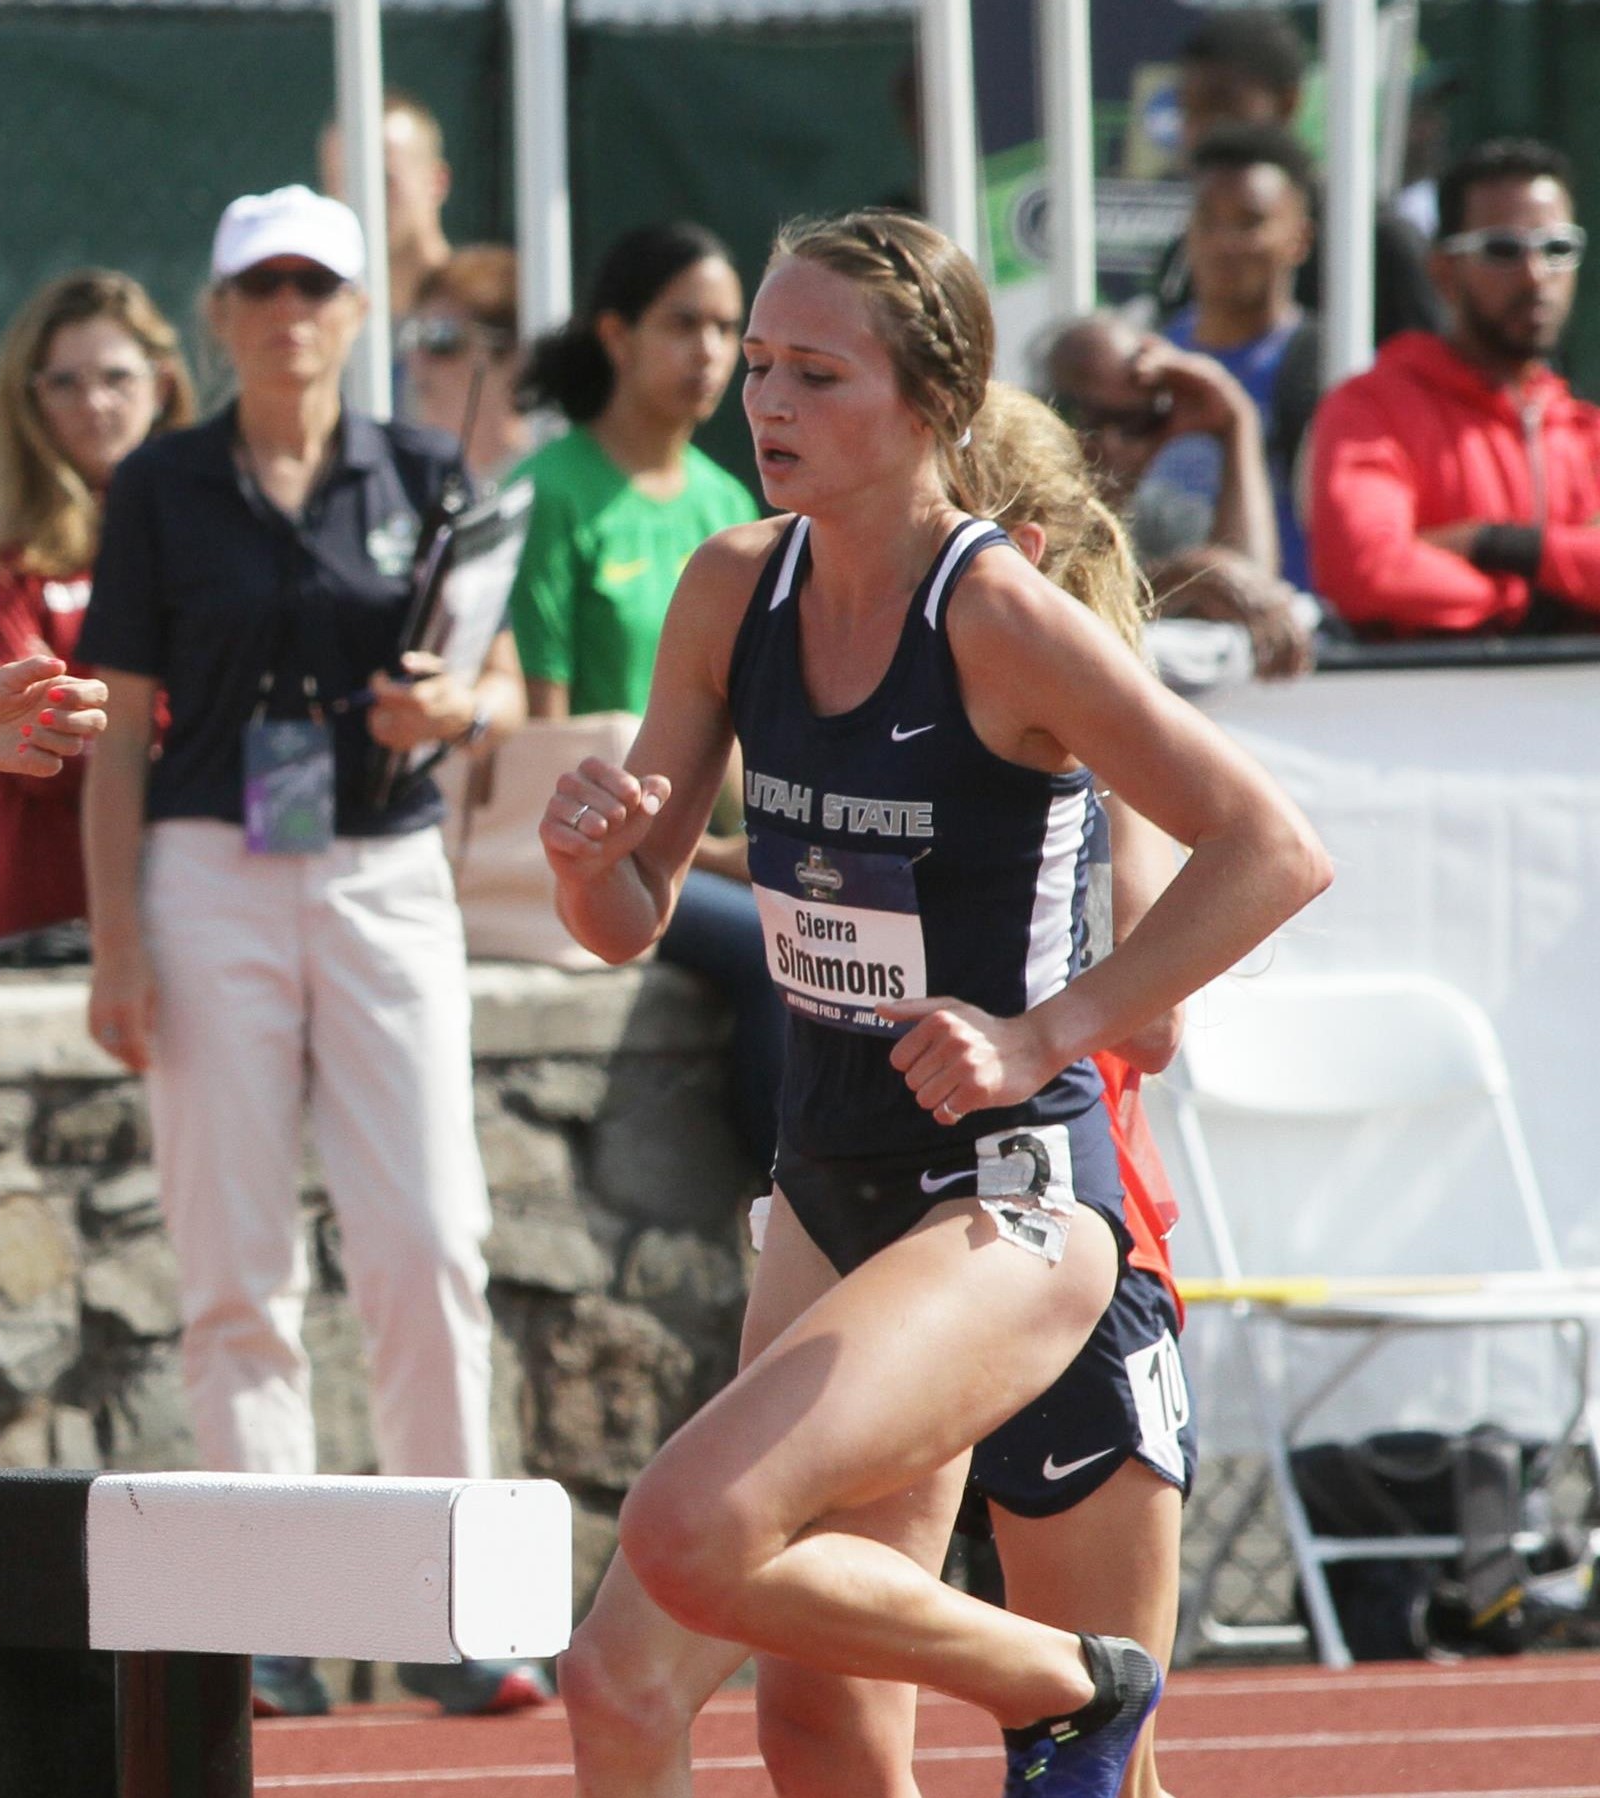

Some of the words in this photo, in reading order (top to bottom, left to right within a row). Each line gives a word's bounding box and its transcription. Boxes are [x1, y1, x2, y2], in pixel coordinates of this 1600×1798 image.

[746, 770, 813, 823] UTAH
[822, 793, 934, 837] STATE
[795, 909, 857, 943] Cierra
[776, 931, 905, 1000] Simmons
[819, 1003, 841, 1020] FIELD
[852, 1011, 878, 1026] JUNE
[1148, 1341, 1183, 1432] 10
